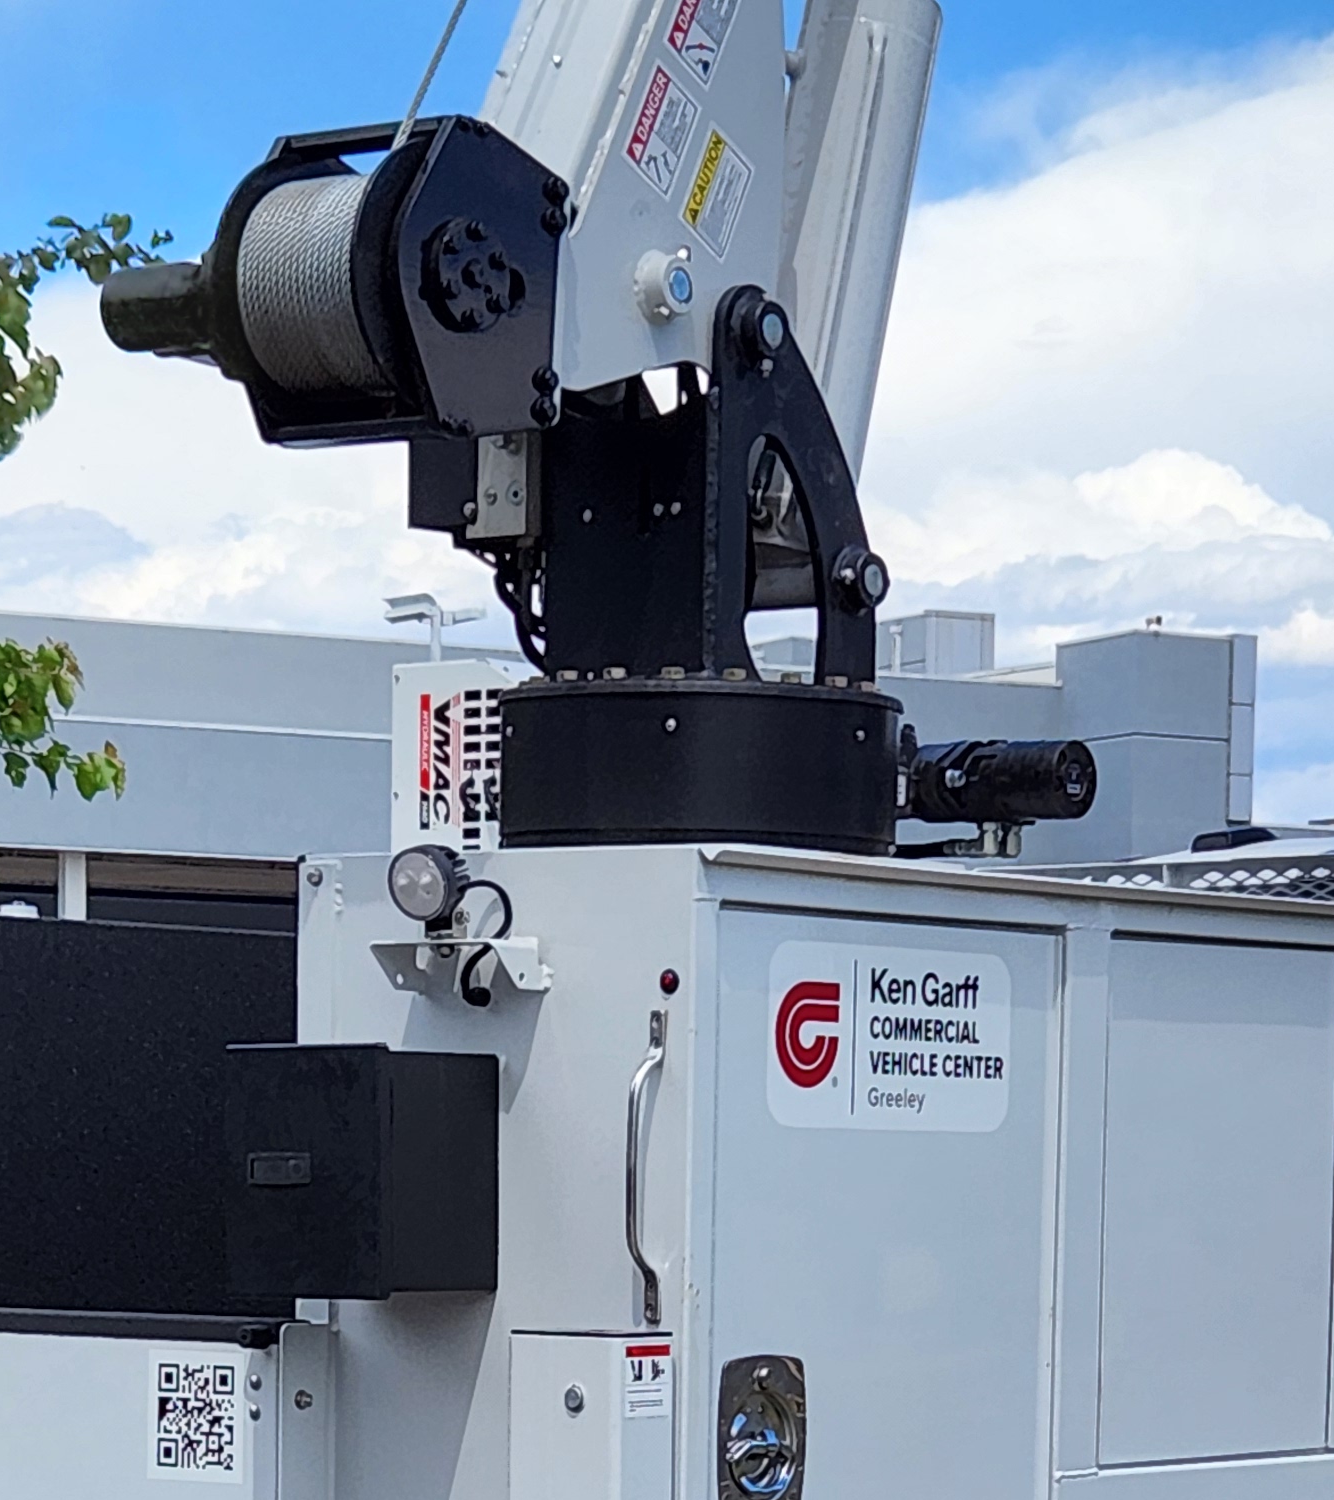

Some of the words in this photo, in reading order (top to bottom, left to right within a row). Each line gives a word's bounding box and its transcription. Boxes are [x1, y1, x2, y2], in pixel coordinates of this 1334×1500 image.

[637, 74, 670, 142] DANGER
[692, 135, 723, 206] CAUTION
[433, 699, 450, 825] VMAC
[870, 967, 917, 1006] Ken
[921, 972, 980, 1010] Garff
[869, 1015, 980, 1044] COMMERCIAL
[869, 1050, 938, 1077] VEHICLE
[942, 1054, 1004, 1080] CENTER
[867, 1087, 926, 1115] Greeley
